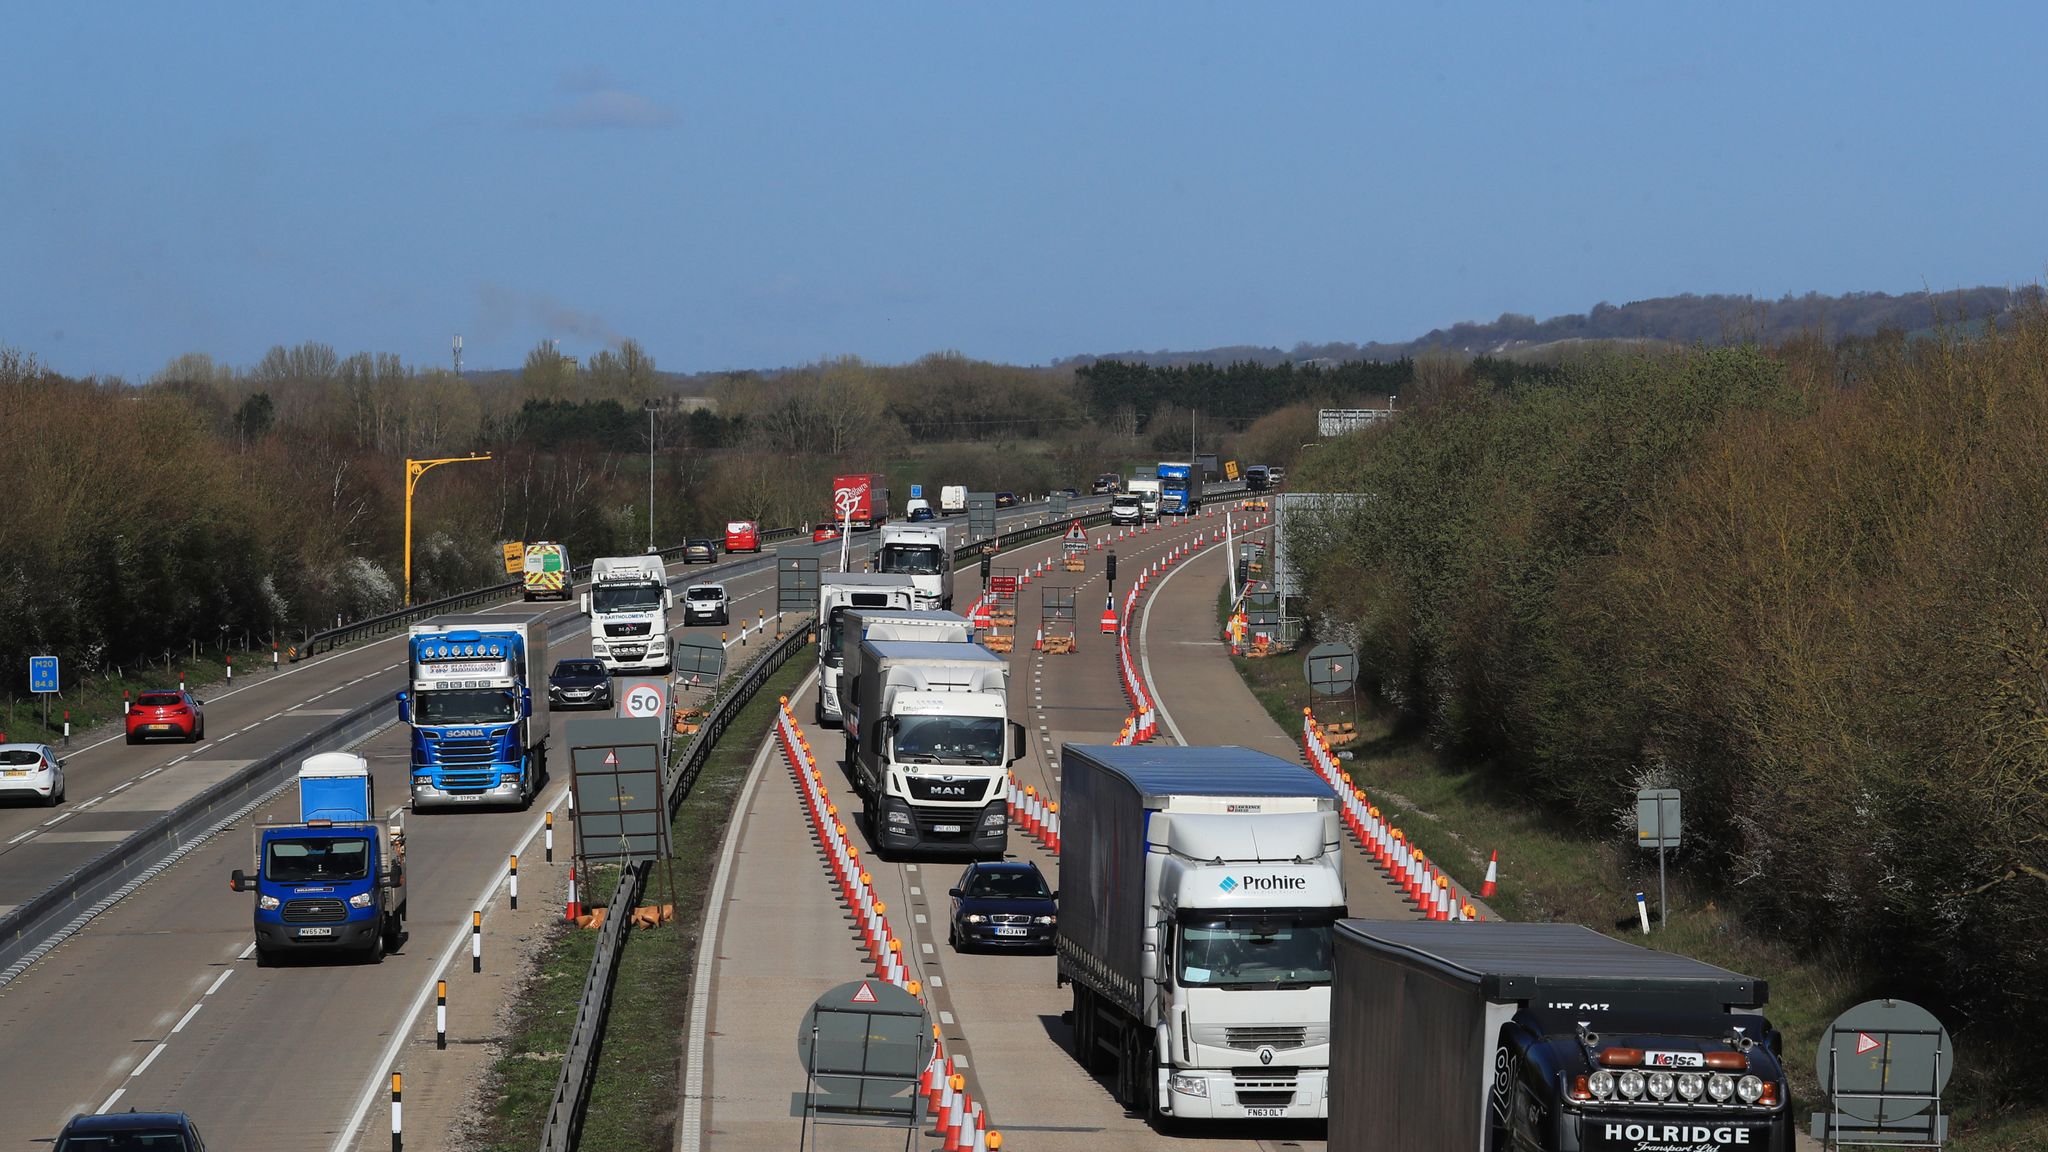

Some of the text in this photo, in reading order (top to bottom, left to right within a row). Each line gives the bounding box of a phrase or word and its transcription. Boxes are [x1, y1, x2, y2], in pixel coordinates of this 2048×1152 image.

[35, 660, 53, 668] M20
[631, 695, 659, 712] 50
[446, 729, 484, 738] SCANIA
[930, 786, 965, 795] MAN
[1243, 875, 1306, 890] Prohire
[1652, 1053, 1697, 1066] Kelsa
[1605, 1124, 1750, 1144] HOLRIDGE
[1633, 1141, 1721, 1152] Transport Ltd
